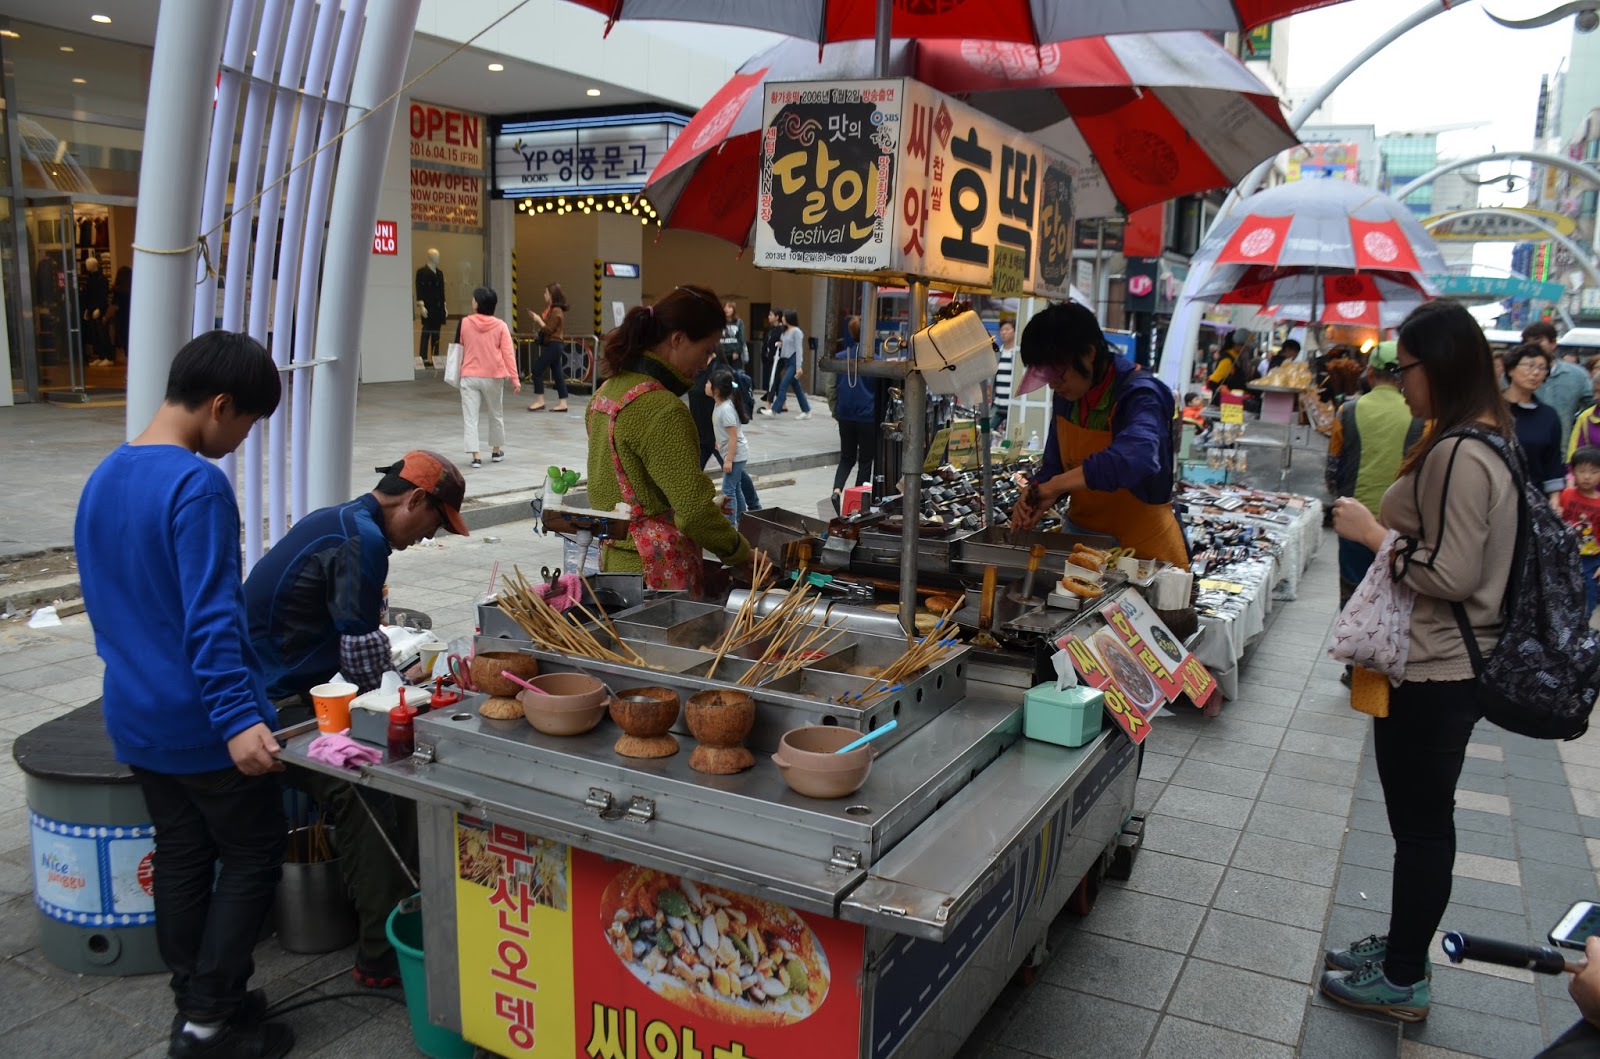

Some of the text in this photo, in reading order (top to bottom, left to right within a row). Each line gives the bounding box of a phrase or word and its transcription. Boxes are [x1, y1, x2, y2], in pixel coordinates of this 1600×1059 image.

[801, 90, 829, 103] 2006년
[846, 89, 861, 103] 2일
[863, 88, 895, 102] 방송출연
[410, 104, 478, 148] OPEN
[829, 113, 861, 142] 맛의
[884, 113, 899, 121] SBS
[410, 143, 479, 165] 2016.04.15 (FRI)
[522, 145, 647, 181] YP 영풍문고
[410, 168, 479, 193] NOW OPEN
[522, 174, 548, 183] BOOKS
[773, 138, 880, 239] 달인
[904, 103, 934, 258] 씨앗
[931, 155, 944, 212] 찹쌀
[410, 189, 479, 207] NOW OPEN NOW
[429, 204, 445, 214] NOW
[941, 127, 1038, 281] 호떡
[375, 225, 393, 237] UNI
[790, 224, 846, 245] festival
[375, 239, 395, 253] QLO
[765, 252, 787, 261] 2013년
[789, 252, 802, 261] 10월
[850, 255, 877, 265] 13일(일)
[1111, 608, 1175, 685] 호떡
[1066, 634, 1144, 735] 씨앗
[42, 852, 69, 874] Nice
